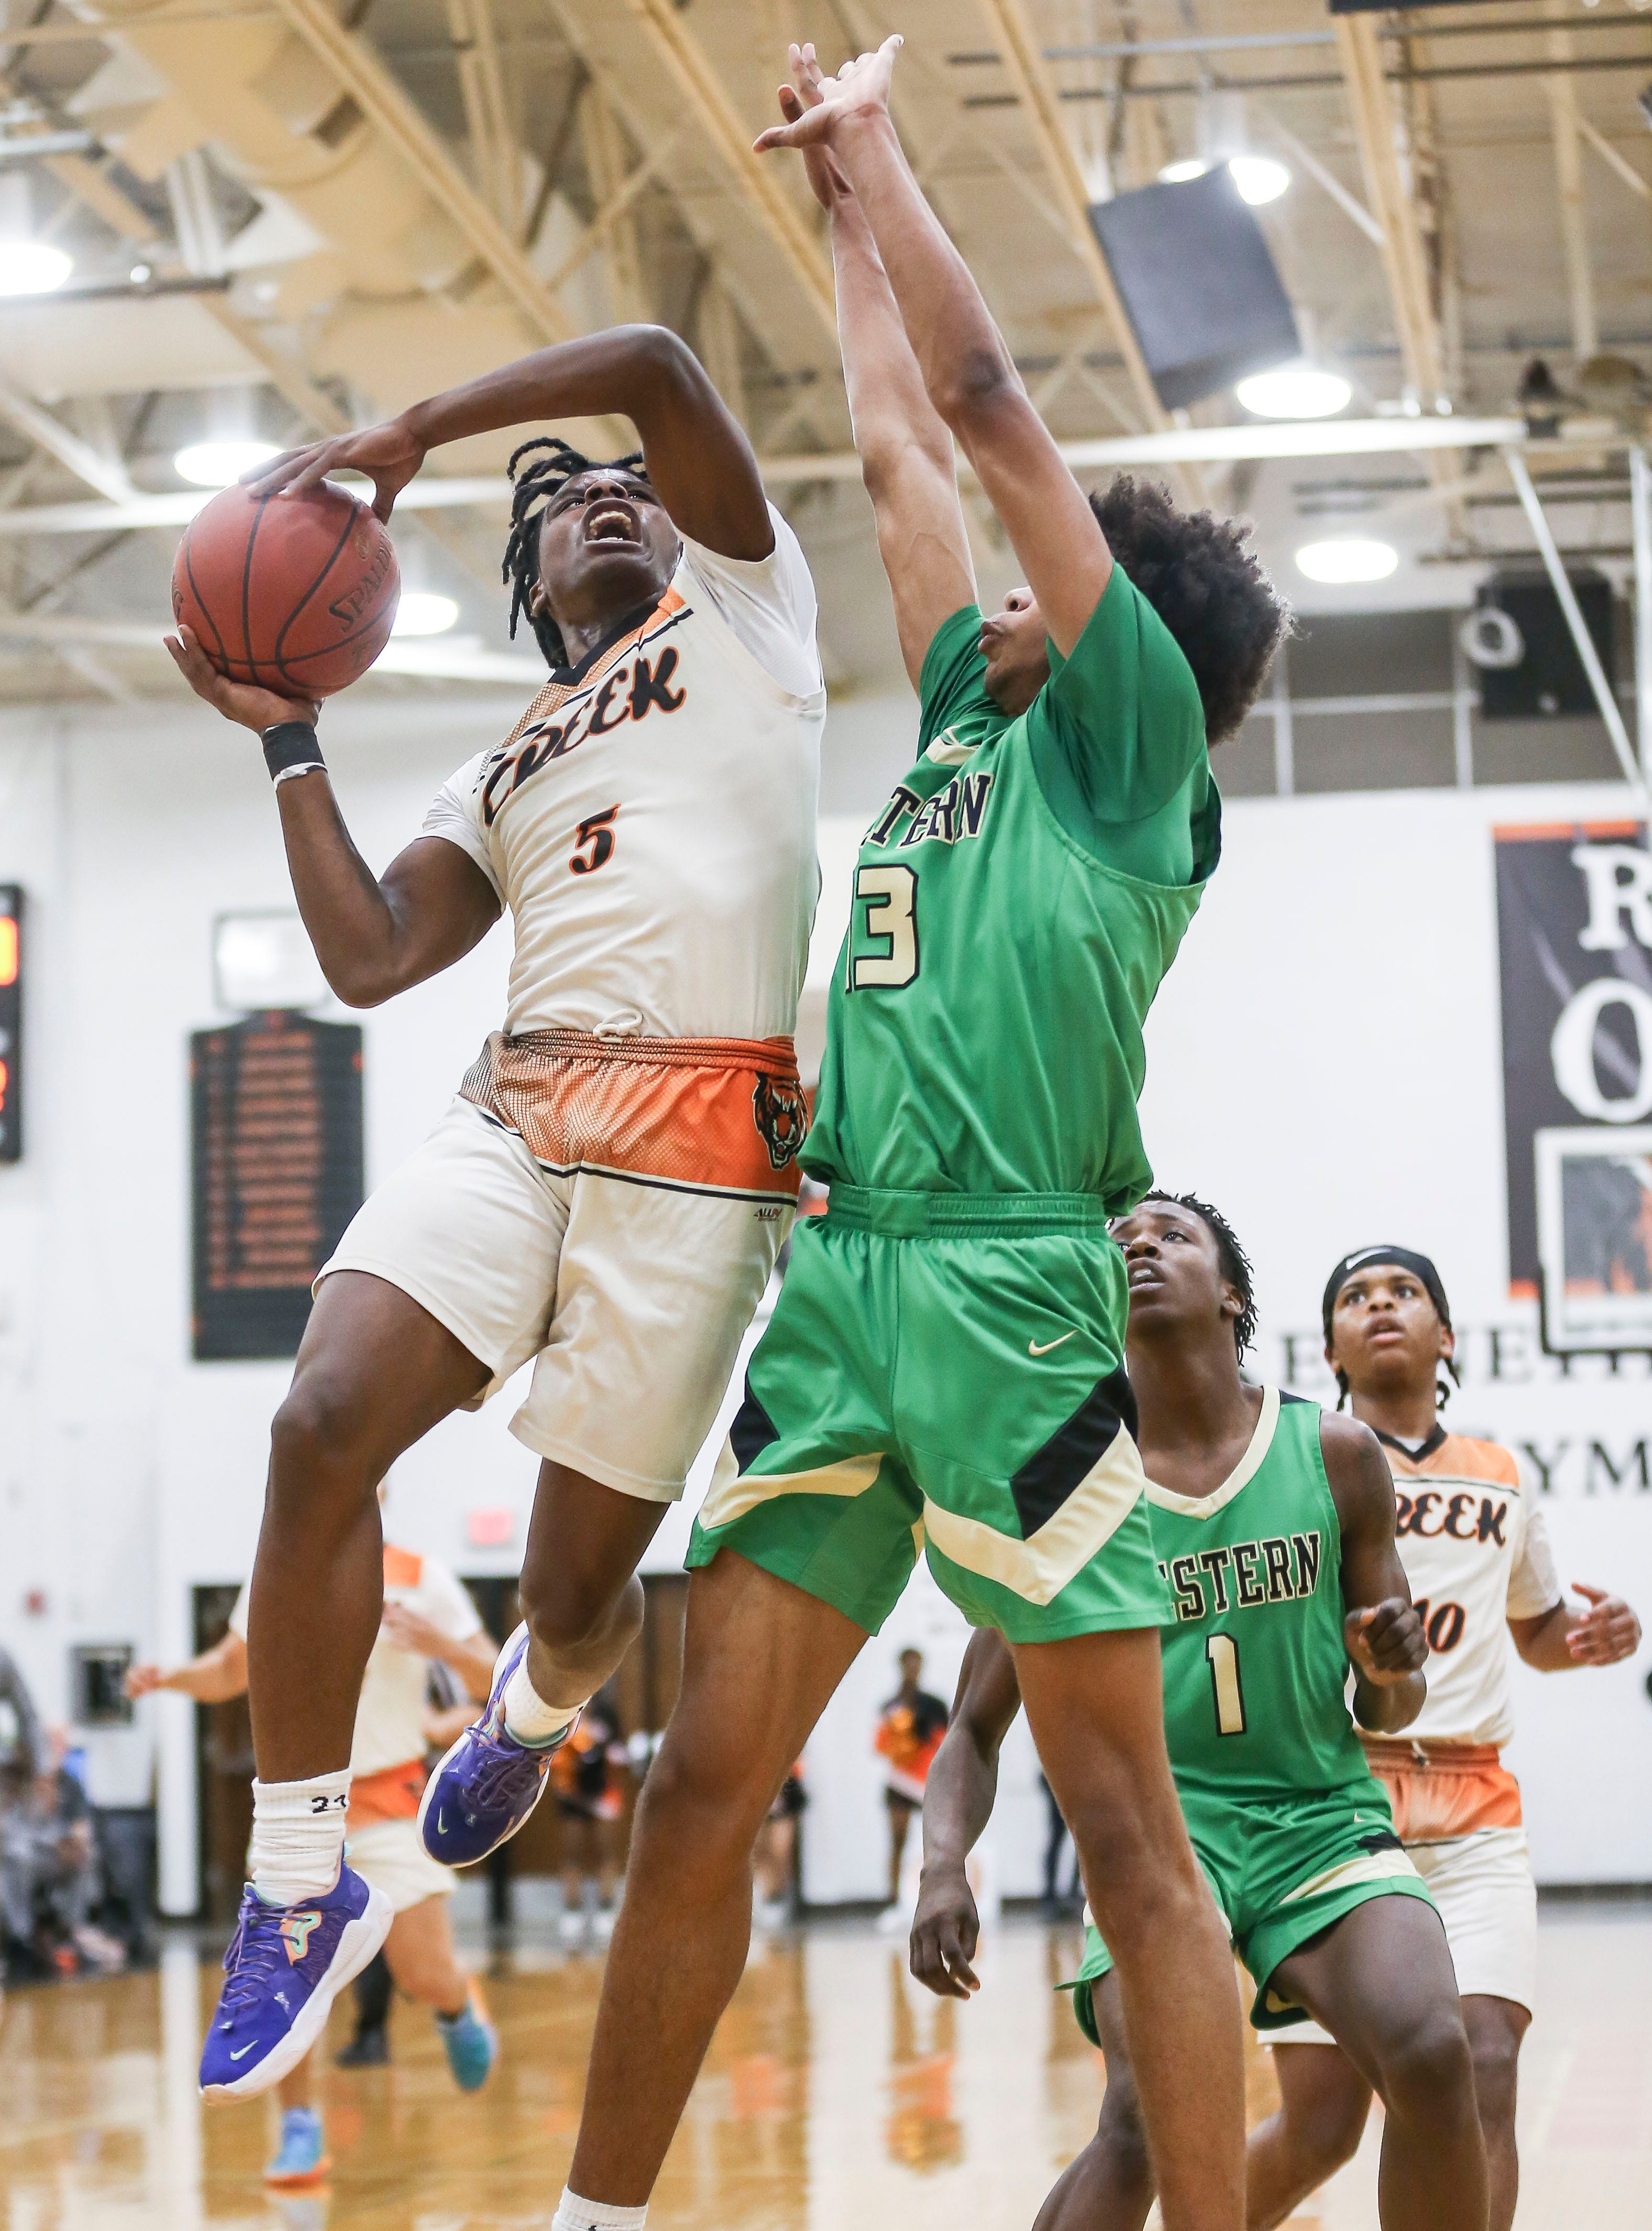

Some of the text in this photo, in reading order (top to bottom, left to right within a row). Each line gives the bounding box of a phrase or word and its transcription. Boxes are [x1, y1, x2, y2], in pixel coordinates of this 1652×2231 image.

[482, 646, 687, 828] CREEK
[569, 802, 621, 876] 5
[859, 771, 994, 849] TERN
[845, 863, 920, 994] 3
[1465, 1432, 1652, 1494] YM
[1395, 1493, 1507, 1549] REEK
[1158, 1530, 1321, 1623] STERN
[1205, 1631, 1247, 1738] 1
